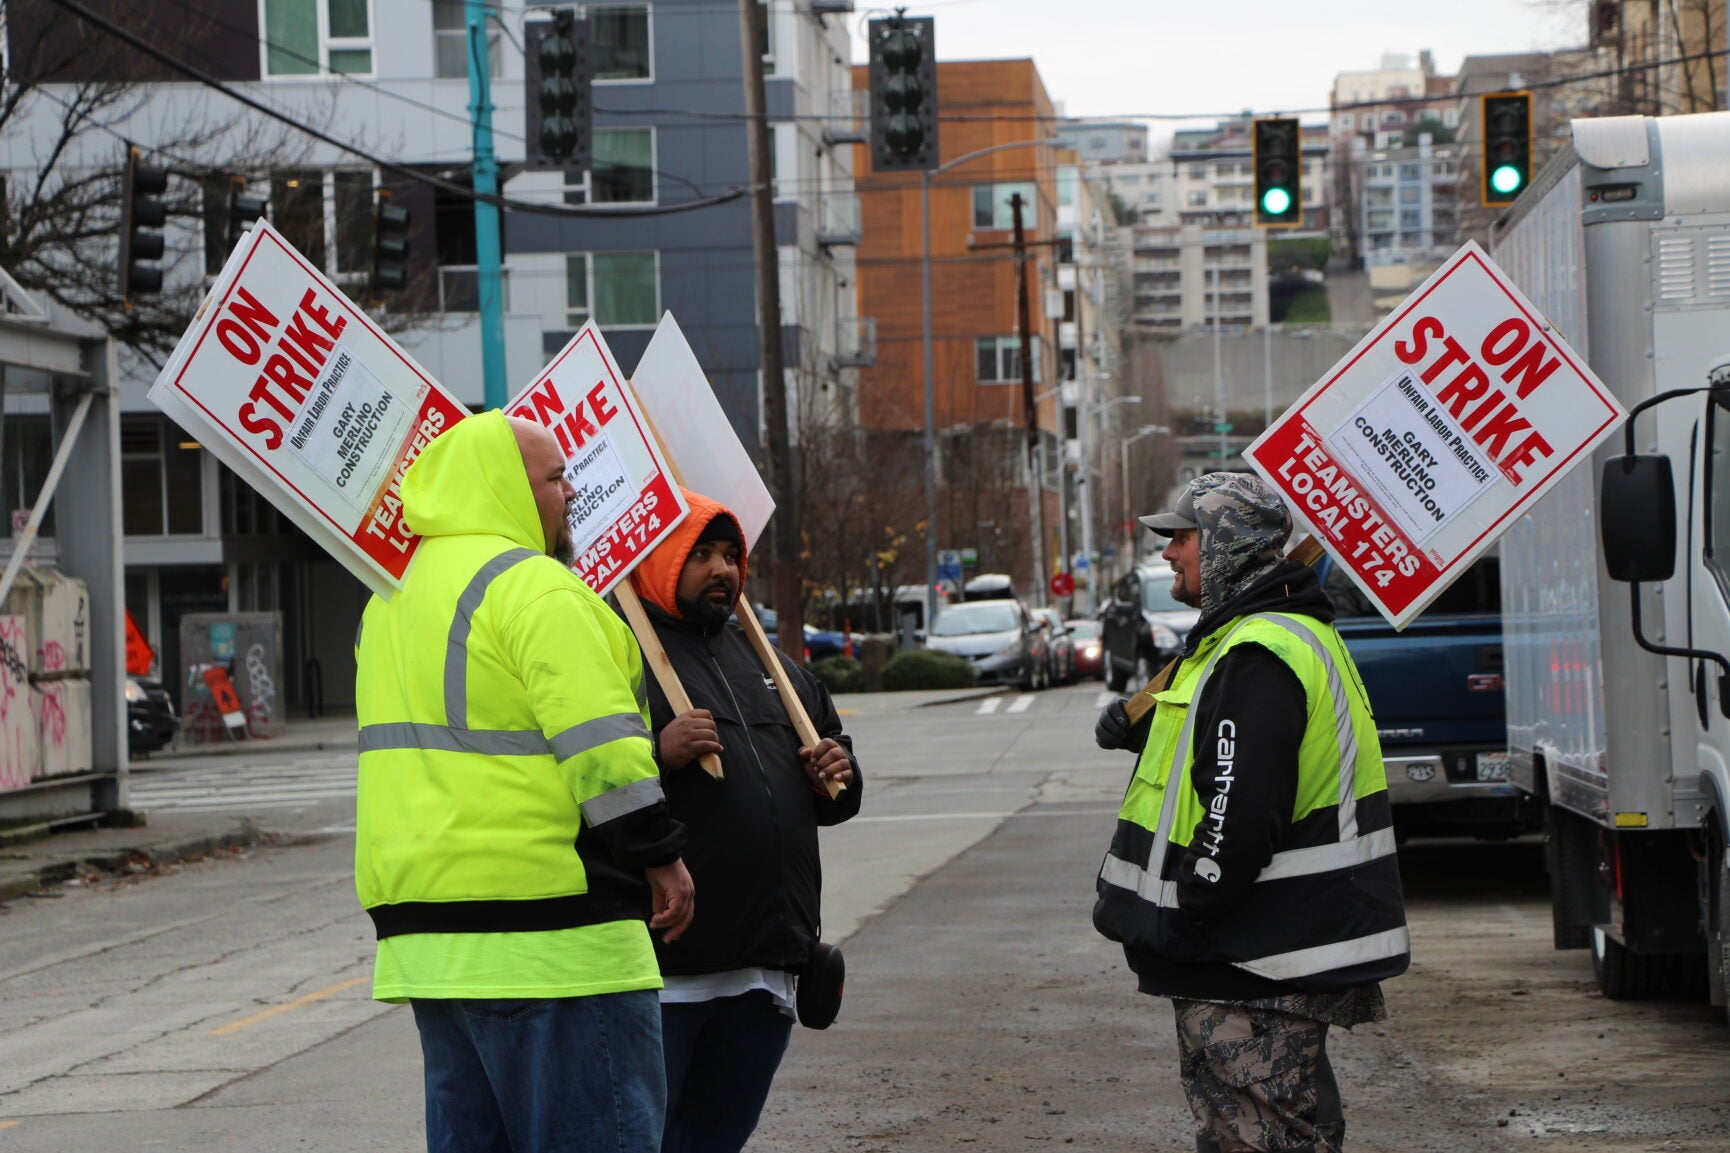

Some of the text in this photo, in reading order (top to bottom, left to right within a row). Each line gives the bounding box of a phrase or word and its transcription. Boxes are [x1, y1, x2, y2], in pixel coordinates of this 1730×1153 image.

[216, 286, 280, 365] ON
[1480, 317, 1562, 400] ON
[238, 287, 347, 450] STRIKE
[290, 352, 351, 450] UNFAIR LABOR PRACTICE
[1394, 316, 1555, 487] STRIKE
[332, 401, 356, 438] GARY
[336, 402, 372, 460] MERLINO
[336, 391, 393, 488] CONSTRUCTION
[553, 380, 618, 460] IKE
[573, 440, 608, 476] PRACTICE
[1382, 428, 1436, 490] MERLINO
[1398, 375, 1490, 484] UNFAIR LABOR PRACTICE
[1403, 431, 1439, 469] GARY
[566, 484, 603, 523] ERLINO
[567, 483, 588, 505] ARY
[570, 475, 625, 530] TRUCTION
[1294, 432, 1421, 577] TEAMSTERS
[1355, 416, 1445, 522] CONSTRUCTION
[571, 491, 658, 577] MSTERS
[584, 555, 622, 590] CAL
[625, 513, 661, 552] 174
[1278, 456, 1349, 541] LOCAL
[1351, 540, 1396, 588] 174
[1202, 719, 1236, 857] carhartt
